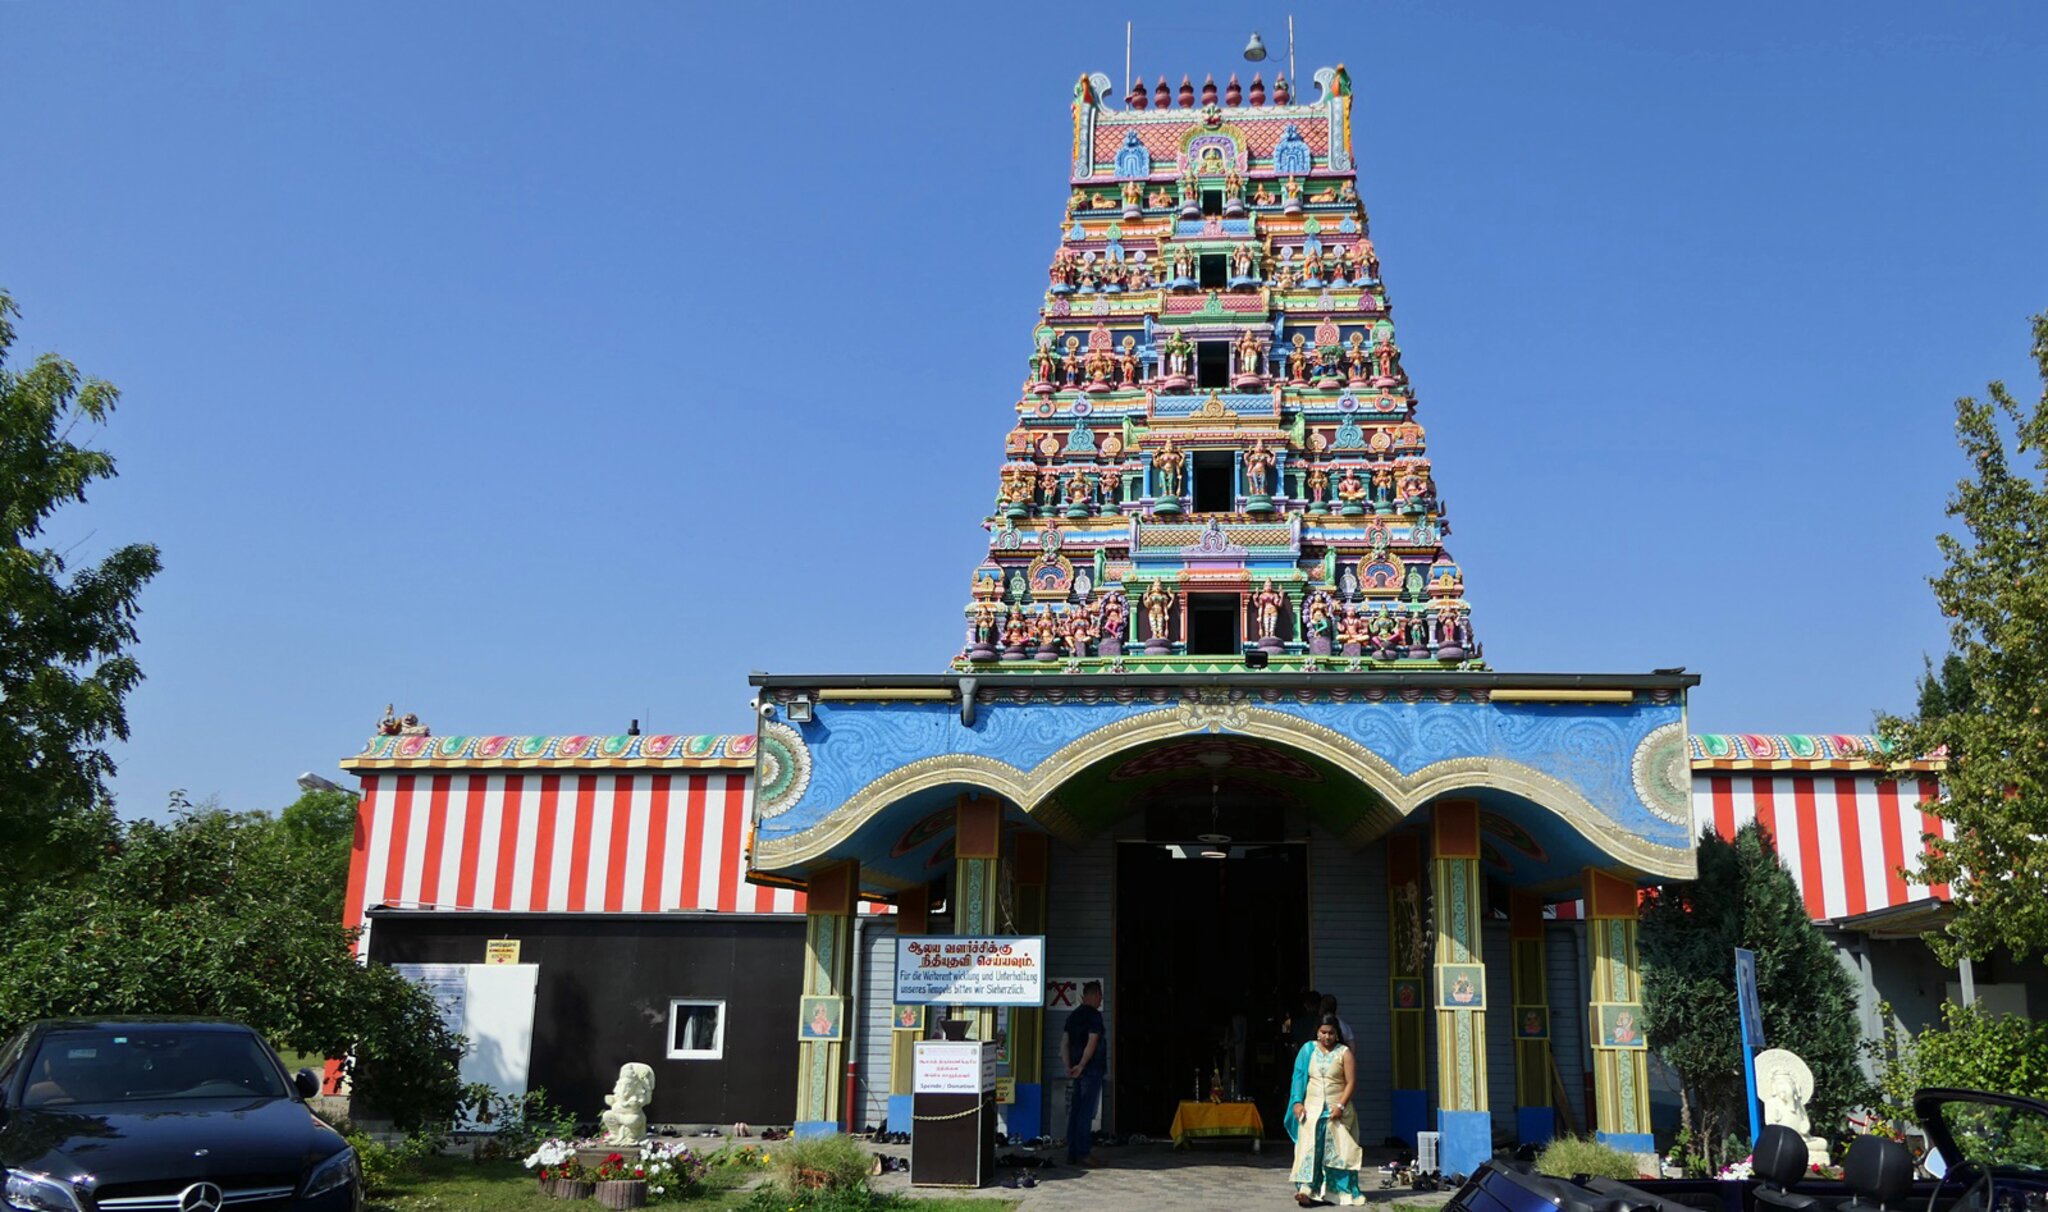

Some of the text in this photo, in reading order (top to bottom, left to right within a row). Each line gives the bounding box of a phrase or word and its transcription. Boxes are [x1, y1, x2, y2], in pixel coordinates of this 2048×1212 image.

[908, 940, 1012, 955] ஆலய வளர்ச்சிக்கு
[920, 954, 972, 968] நிதியுதவி
[900, 970, 911, 980] Für
[912, 970, 922, 980] die
[981, 970, 993, 981] und
[996, 970, 1038, 984] Unterhaltung
[900, 985, 926, 994] unseres
[926, 983, 952, 995] Tempels
[954, 984, 972, 994] bitten
[974, 985, 984, 994] wir
